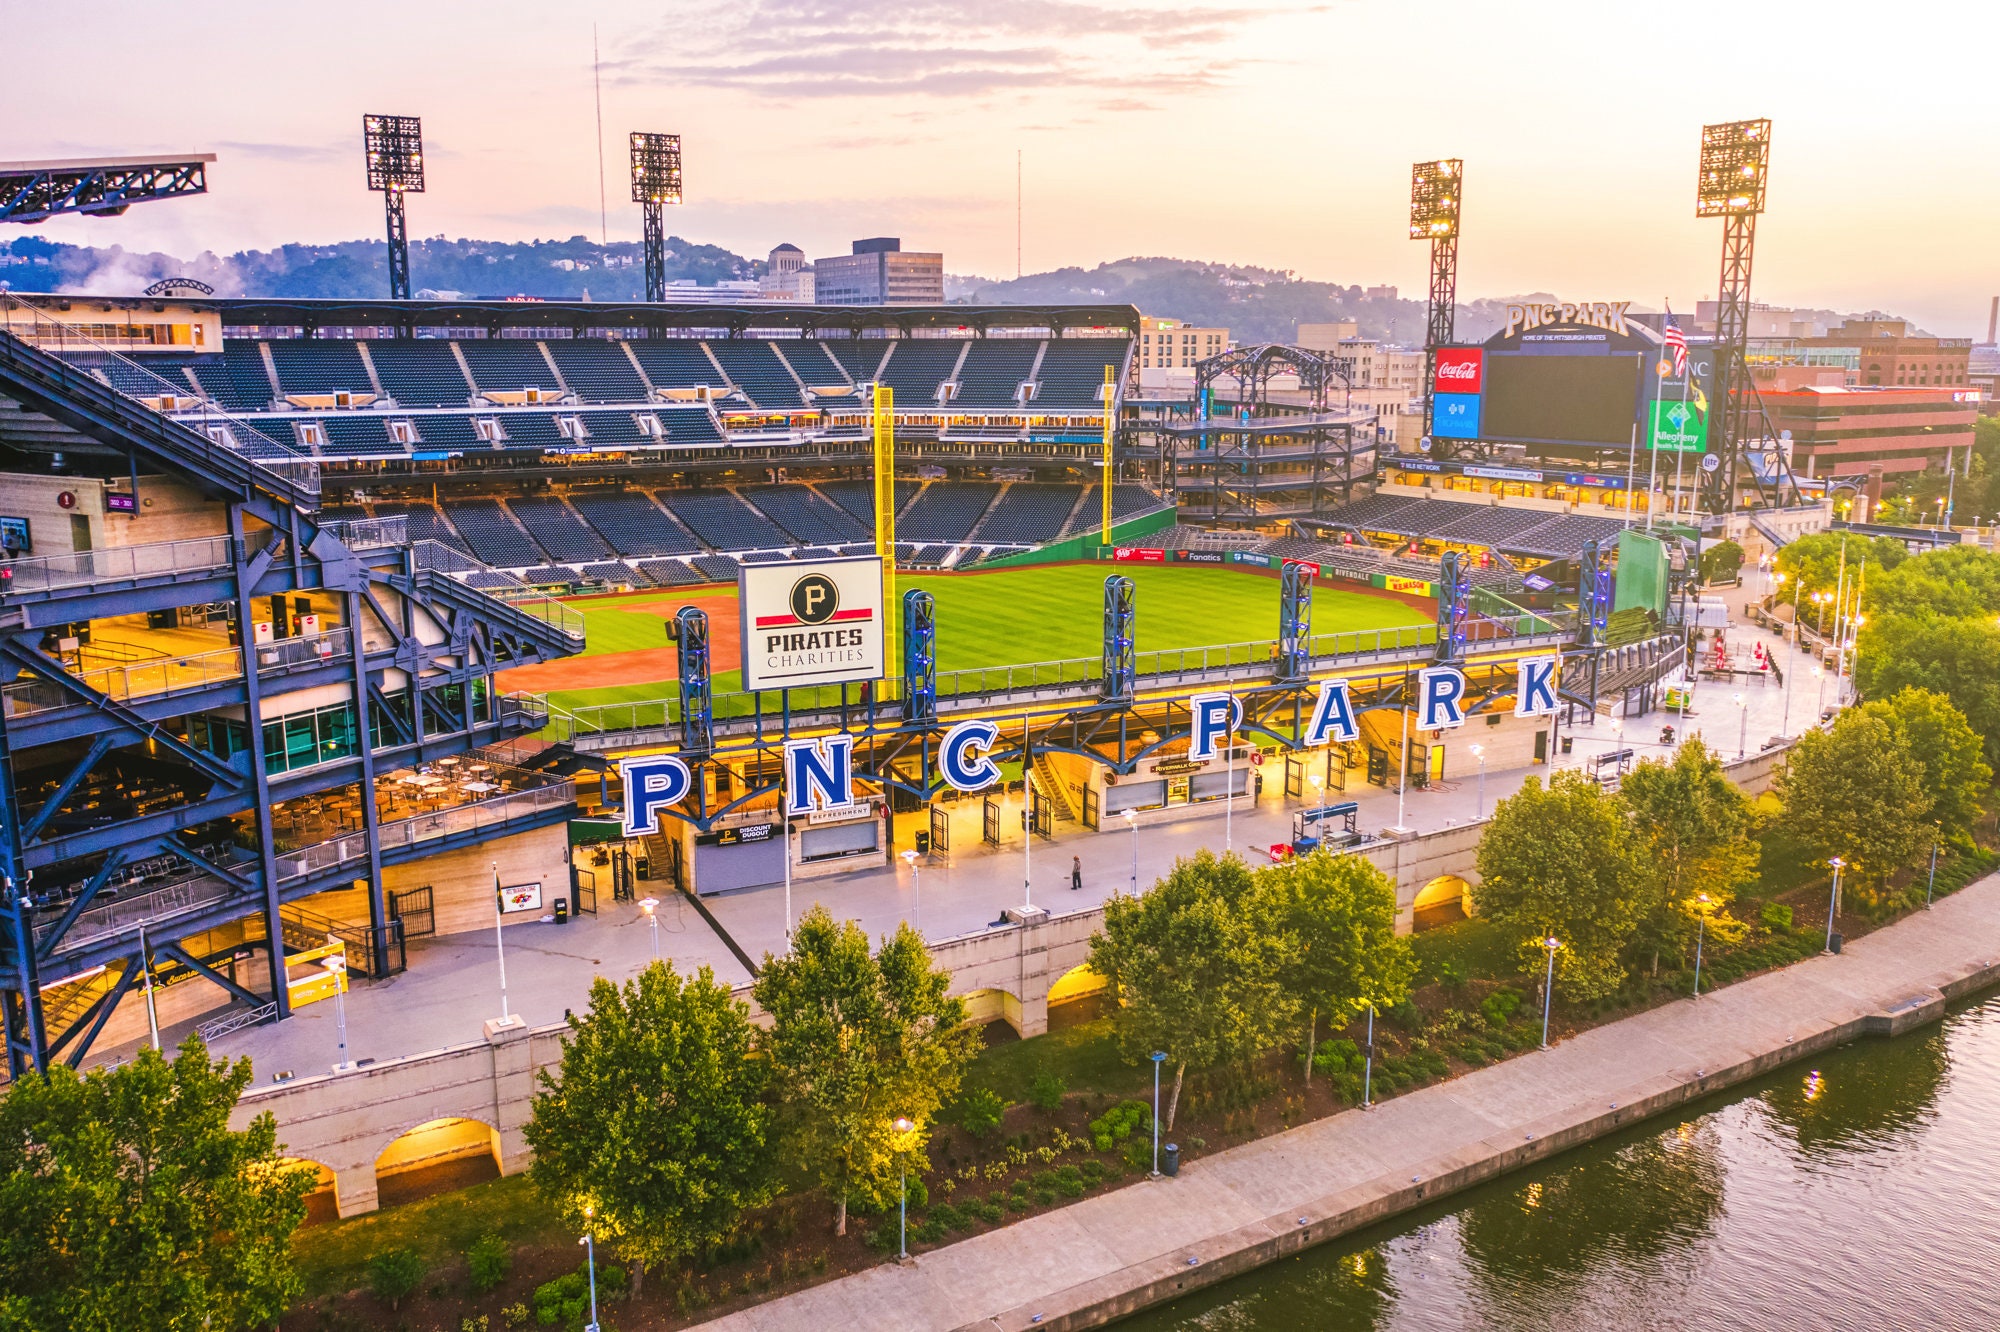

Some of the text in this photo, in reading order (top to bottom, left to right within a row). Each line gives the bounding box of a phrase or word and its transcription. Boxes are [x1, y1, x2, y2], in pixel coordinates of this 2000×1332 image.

[1504, 301, 1630, 339] PNC PARK
[1704, 458, 1718, 467] Lite
[1189, 552, 1221, 562] Fanatics
[805, 584, 826, 615] P
[767, 628, 863, 653] PIRATES
[767, 649, 864, 668] CHARITIES
[619, 654, 1564, 836] PNC PARK
[812, 808, 868, 820] REFRESHMENT
[739, 823, 772, 834] DISCOUNT
[742, 830, 769, 839] DUGOUT
